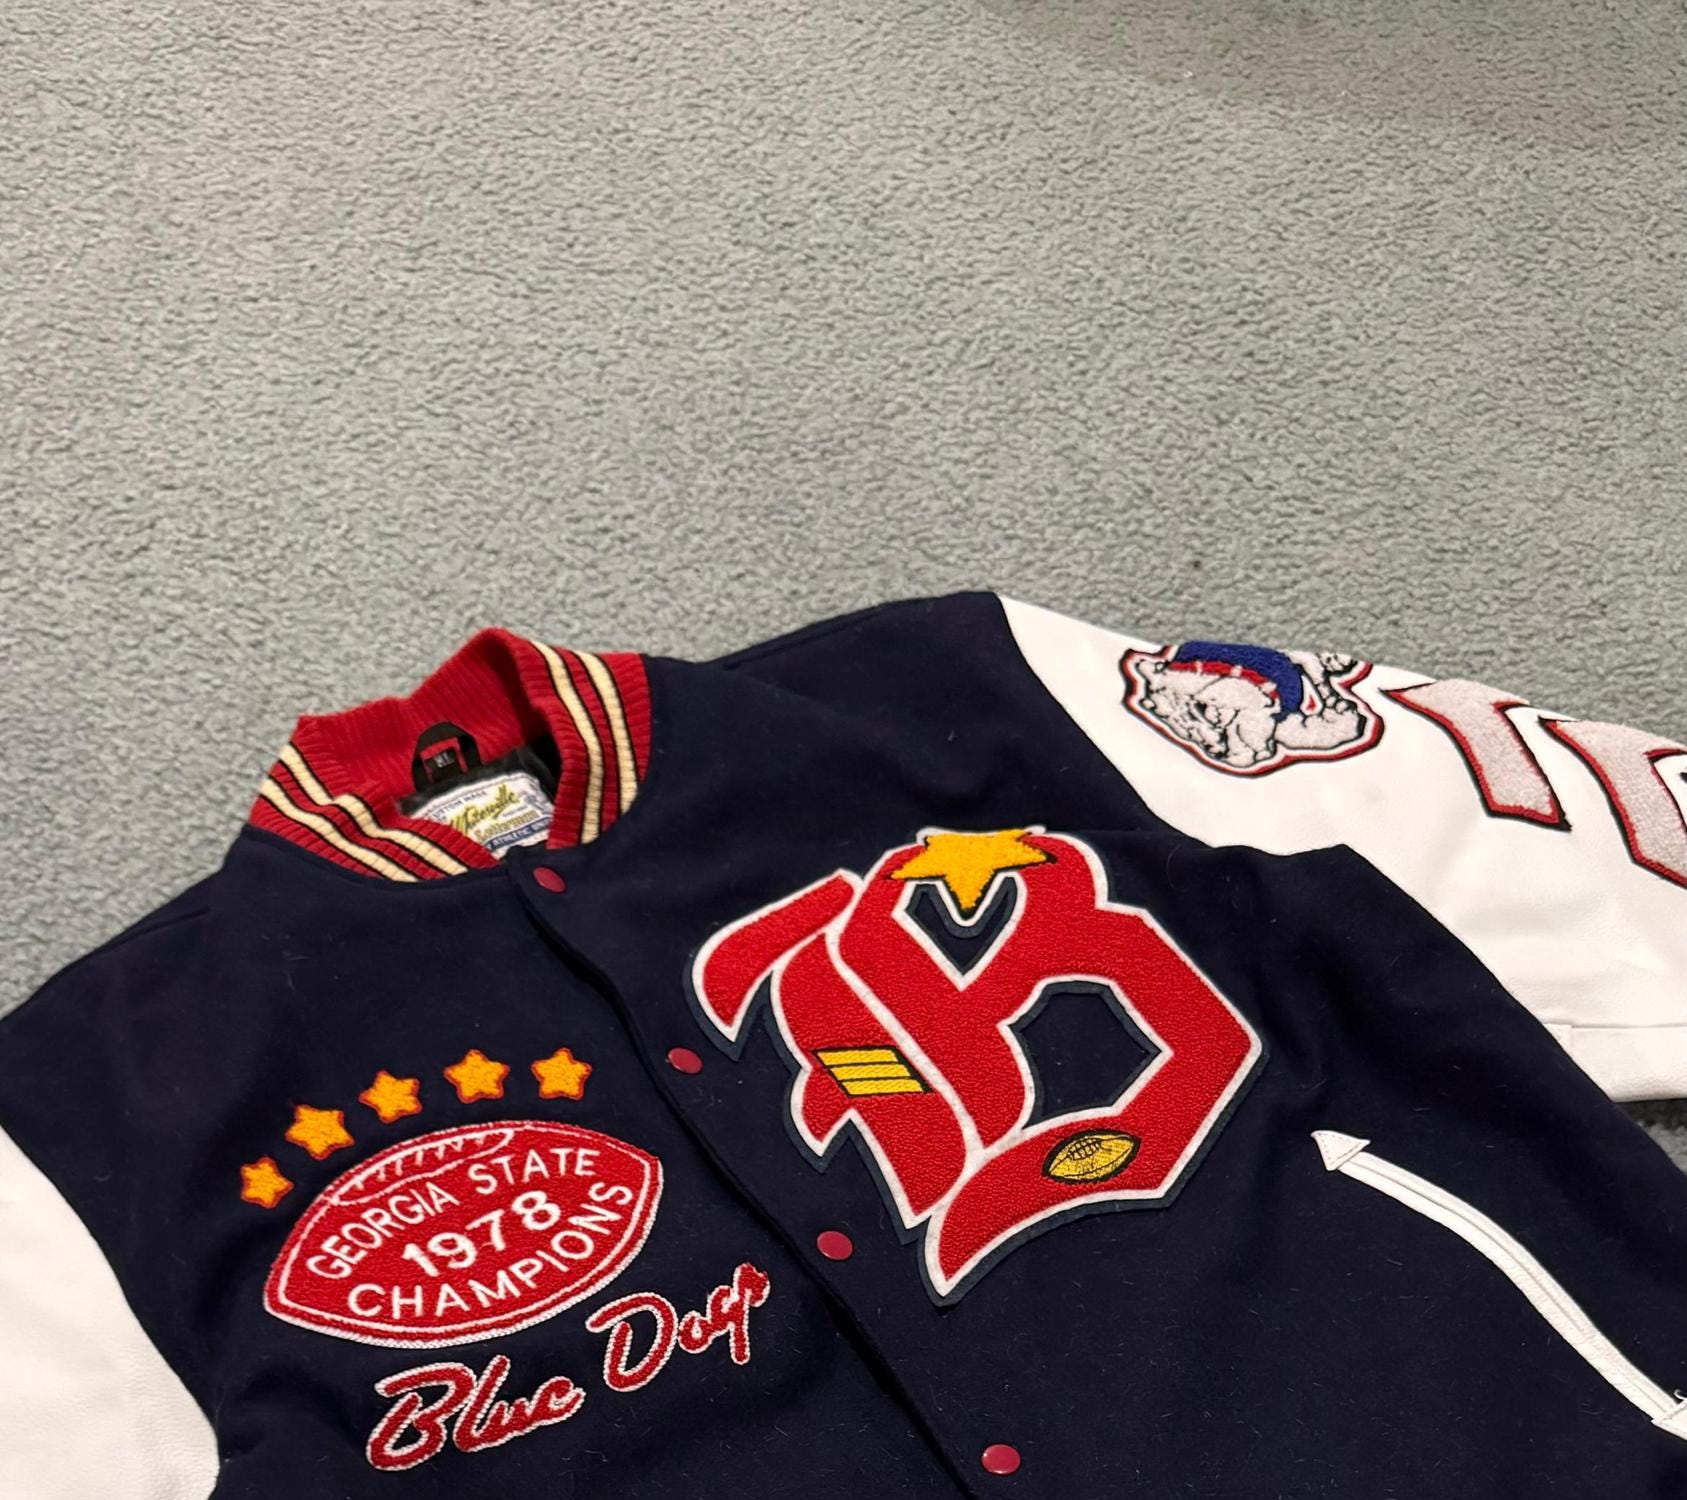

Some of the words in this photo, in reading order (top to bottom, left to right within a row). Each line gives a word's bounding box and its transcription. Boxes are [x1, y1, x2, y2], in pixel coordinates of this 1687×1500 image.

[690, 825, 1263, 1298] B
[306, 1181, 459, 1279] GEORGIA
[468, 1147, 600, 1195] STATE
[347, 1180, 633, 1320] CHAMPIONS
[403, 1190, 561, 1277] 1978
[366, 1354, 586, 1471] Blue
